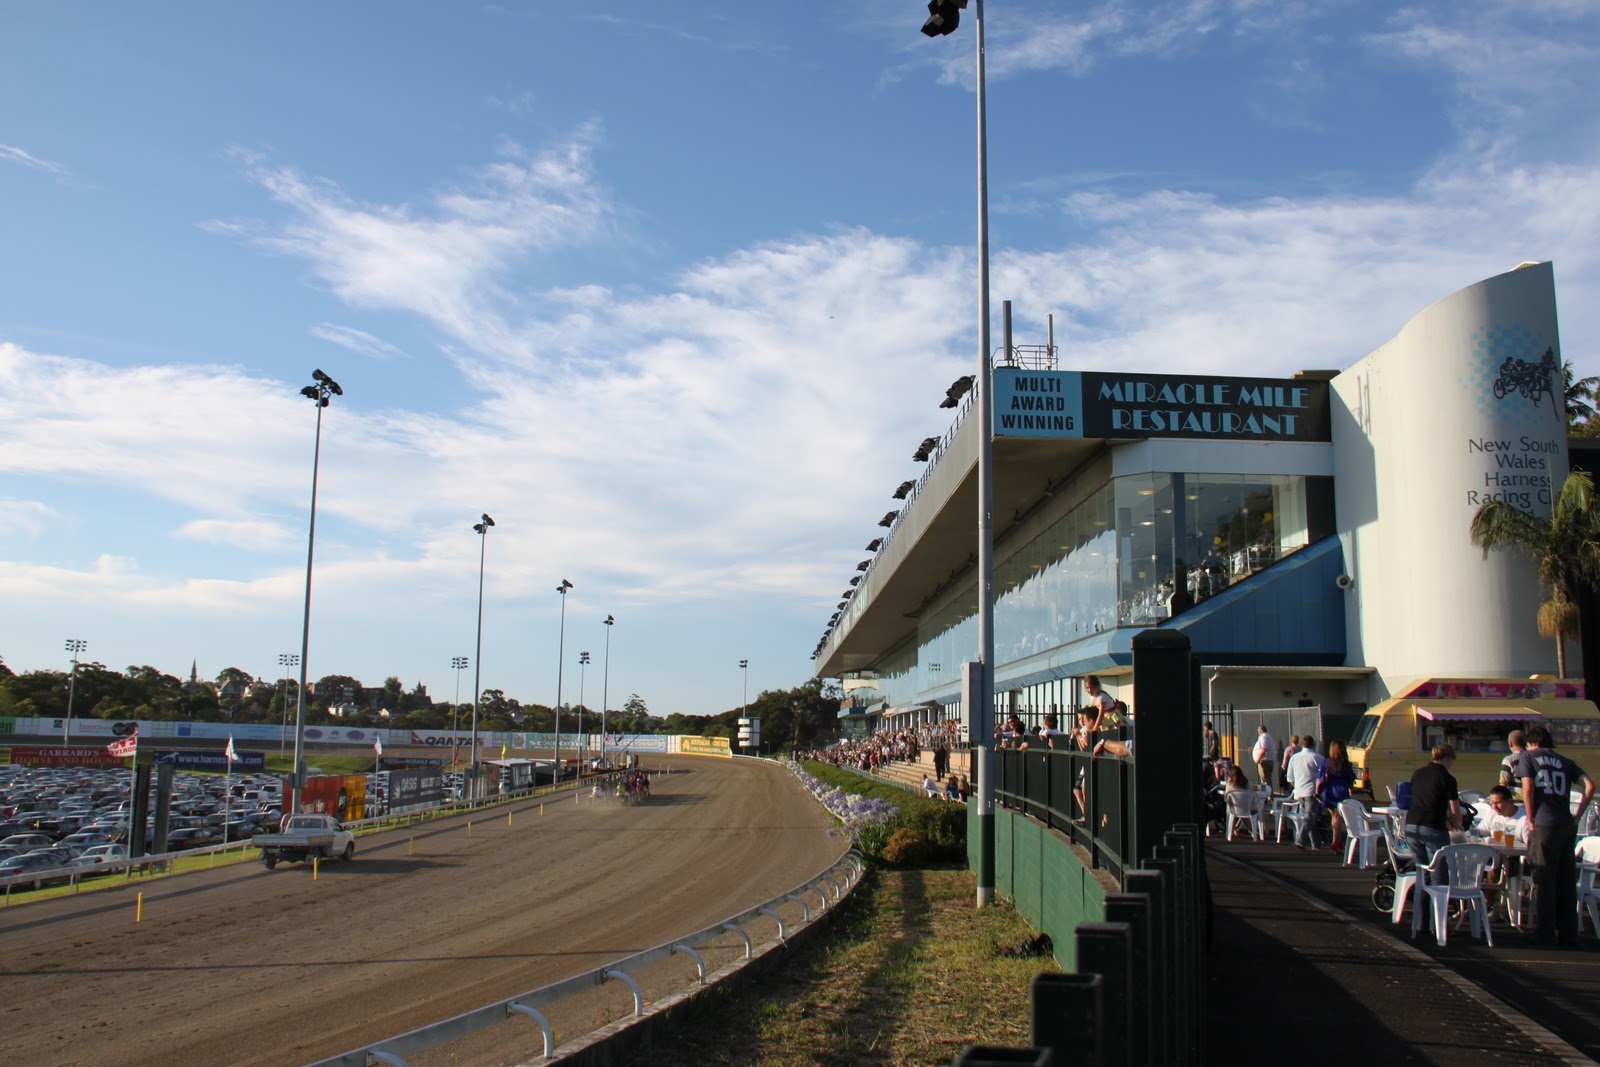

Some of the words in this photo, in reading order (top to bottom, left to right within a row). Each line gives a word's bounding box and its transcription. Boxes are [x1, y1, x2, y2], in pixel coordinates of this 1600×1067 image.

[1015, 377, 1061, 392] MULTI
[1098, 381, 1231, 405] MIRACLE
[1237, 385, 1309, 409] MILE
[1011, 396, 1065, 411] AWARD
[1001, 414, 1074, 430] WINNING
[1112, 409, 1299, 435] RESTAURANT
[1468, 438, 1511, 453] New
[1520, 436, 1559, 454] South
[1495, 453, 1545, 469] Wales
[1484, 472, 1552, 487] Harness
[1467, 490, 1531, 508] Racing
[39, 749, 99, 757] GARRARD'S
[82, 757, 120, 765] HOUND
[1534, 756, 1562, 768] WANG
[1534, 769, 1566, 796] 40
